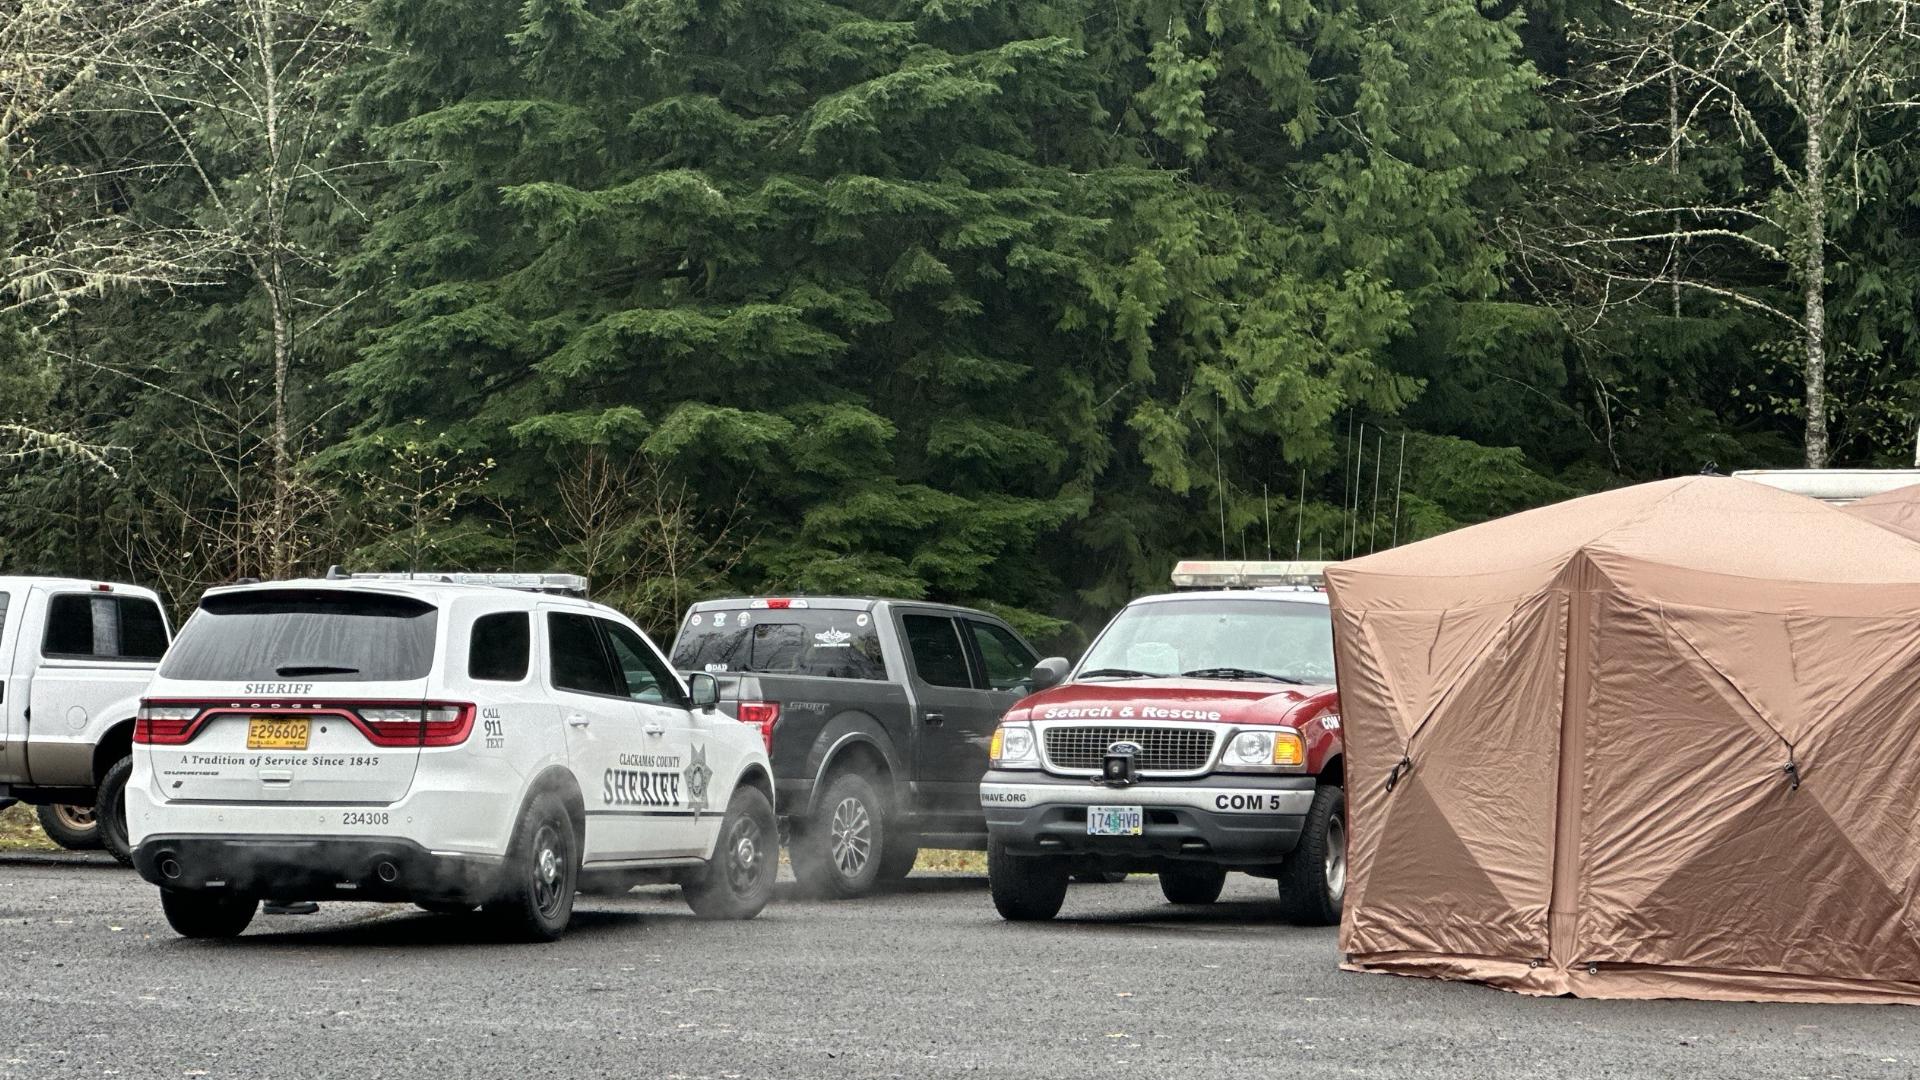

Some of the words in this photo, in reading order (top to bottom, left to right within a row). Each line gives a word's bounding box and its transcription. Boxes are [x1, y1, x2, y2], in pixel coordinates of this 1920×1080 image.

[244, 683, 313, 694] SHERIFF
[482, 707, 501, 719] CALL
[790, 701, 830, 711] SPORT
[1045, 706, 1112, 719] Search
[1119, 706, 1135, 717] &
[1142, 706, 1221, 720] Rescue
[250, 724, 306, 740] E296602
[484, 719, 503, 737] 911
[486, 737, 504, 749] TEXT
[180, 755, 188, 764] A
[192, 755, 245, 765] Tradition
[249, 756, 262, 767] of
[264, 756, 308, 766] Service
[311, 756, 345, 766] Since
[349, 757, 379, 766] 1845
[620, 753, 654, 768] CLACKAMAS
[656, 756, 680, 768] COUNTY
[603, 767, 680, 807] SHERIFF
[1215, 794, 1263, 810] COM
[1269, 795, 1280, 810] 5
[342, 812, 389, 825] 234308
[1091, 812, 1111, 828] 174
[1118, 812, 1140, 828] HVB
